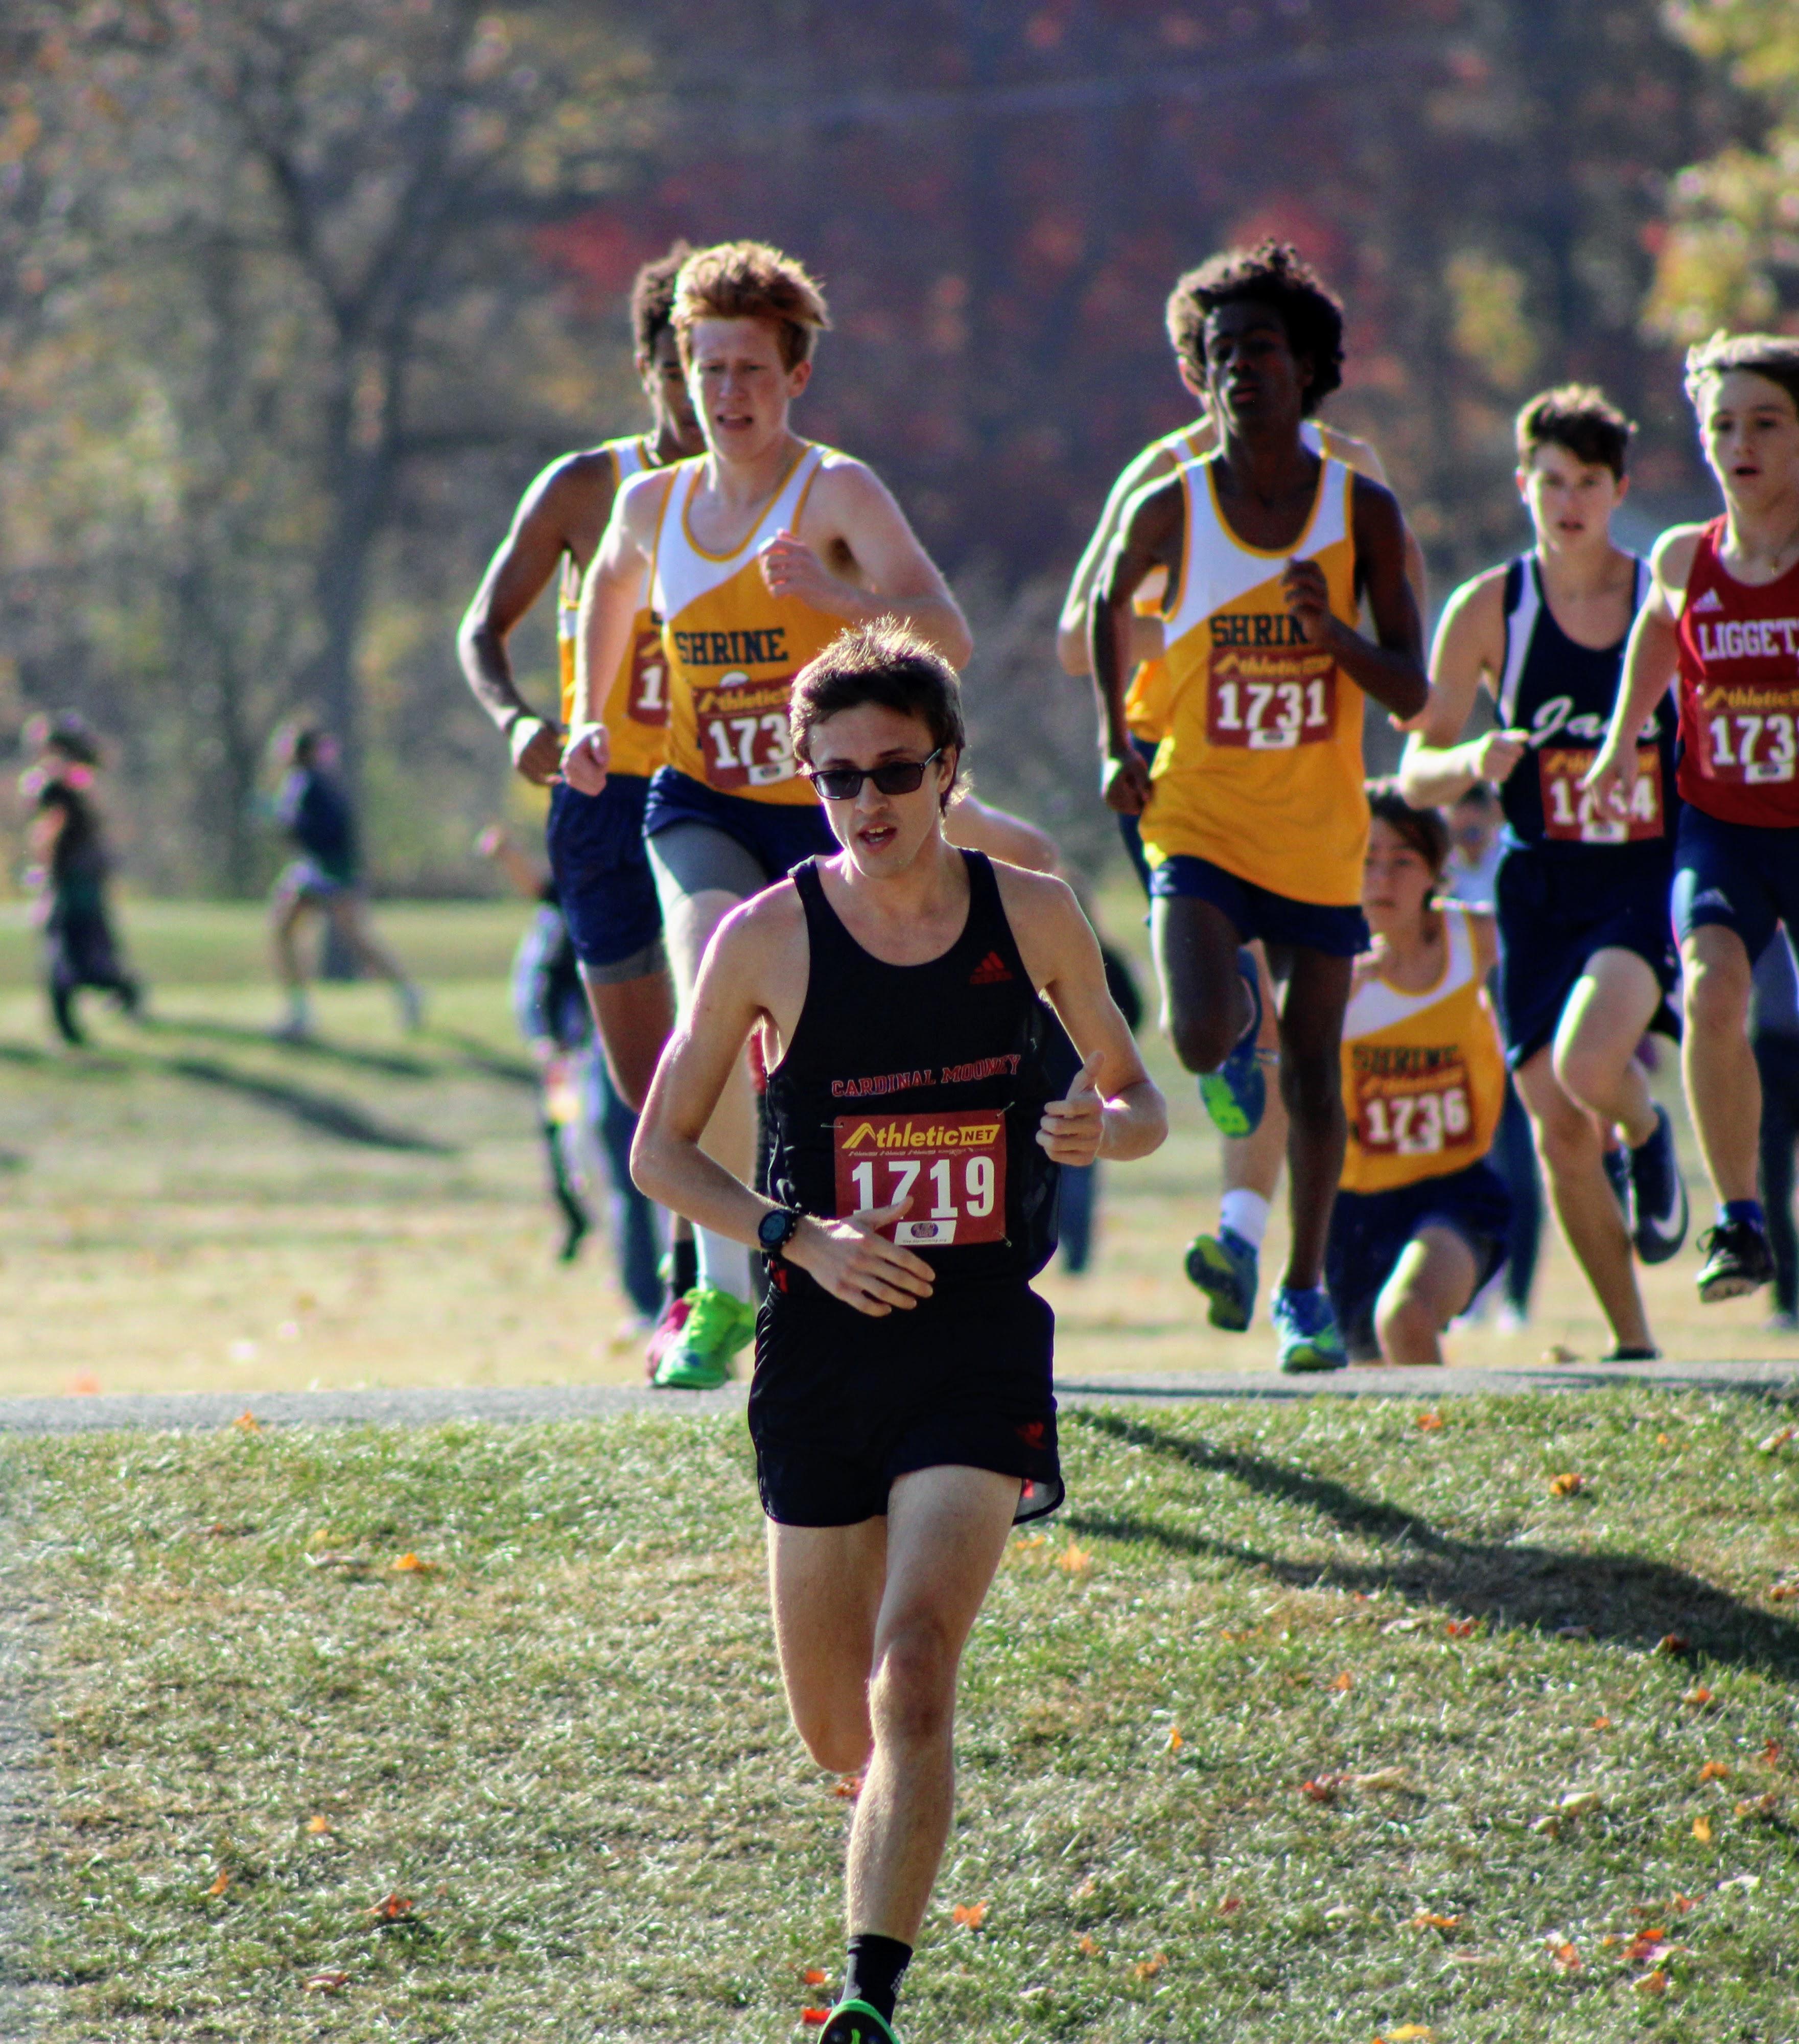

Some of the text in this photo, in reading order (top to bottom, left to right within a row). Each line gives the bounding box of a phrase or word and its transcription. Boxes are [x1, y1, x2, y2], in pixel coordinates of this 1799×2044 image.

[674, 628, 788, 665] SHRINE
[1210, 614, 1309, 647] SHRIN
[1698, 618, 1799, 661] LIGGET
[1217, 679, 1327, 730] 1731
[708, 712, 793, 768] 173
[1709, 714, 1799, 765] 173
[831, 1054, 1021, 1097] CARDINAL MOONEY
[1366, 1088, 1469, 1144] 1736
[851, 1155, 996, 1219] 1719
